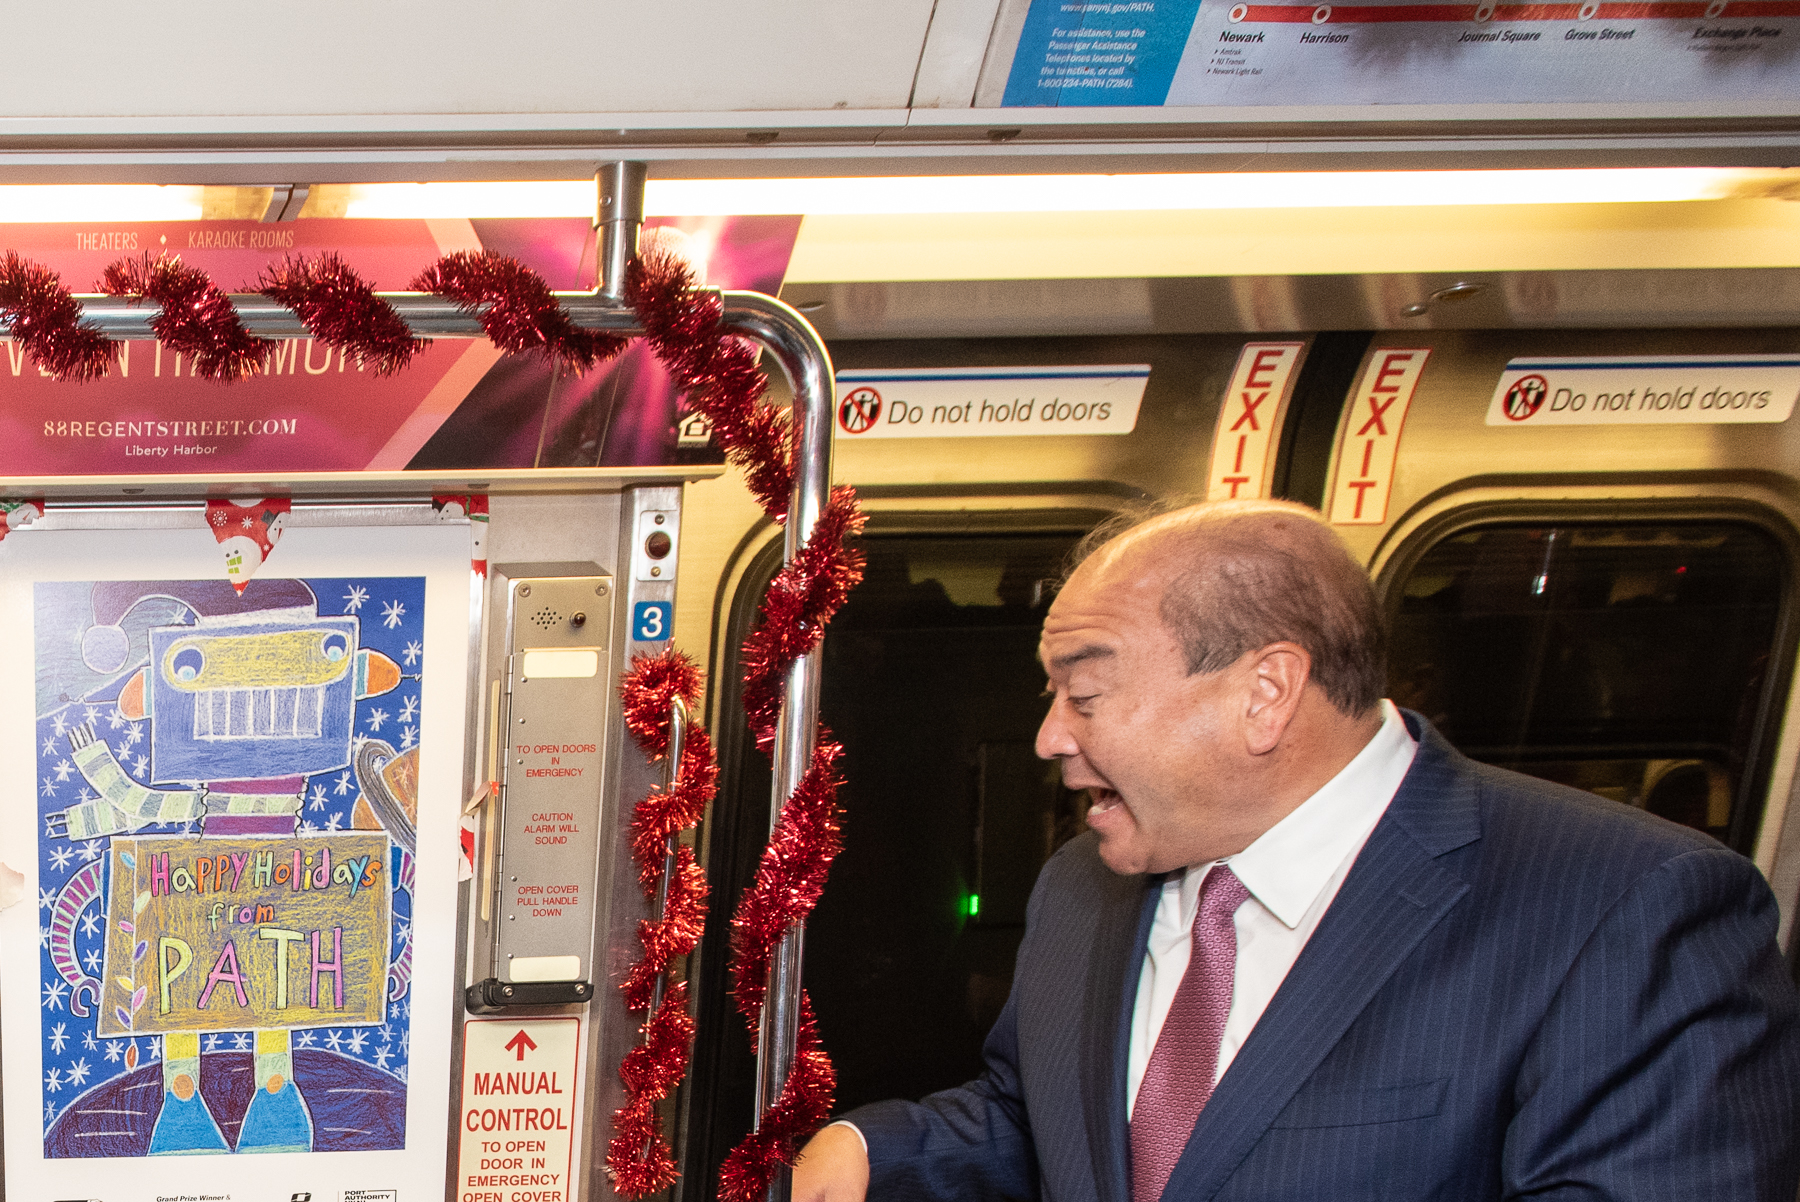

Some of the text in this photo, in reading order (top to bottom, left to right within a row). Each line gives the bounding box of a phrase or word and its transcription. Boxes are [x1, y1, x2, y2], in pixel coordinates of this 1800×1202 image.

[1051, 27, 1146, 38] For assistance, use the
[1219, 30, 1265, 42] Newark
[1300, 32, 1350, 44] Harrison
[1457, 30, 1541, 44] Journal Square
[1564, 28, 1636, 41] Grove Street
[1092, 41, 1138, 51] Assistance
[1092, 54, 1123, 63] located
[1124, 54, 1136, 64] by
[1041, 66, 1055, 76] the
[1098, 67, 1107, 76] or
[1108, 66, 1125, 76] call
[76, 230, 294, 250] THEATERS KARAOKE ROOMS
[1550, 386, 1772, 412] Do not hold doors
[888, 398, 1112, 424] Do not hold doors
[43, 418, 298, 438] 88REGENTSTREET.COM
[1222, 350, 1286, 499] EXIT
[1348, 353, 1414, 519] EXIT
[125, 443, 218, 457] Liberty Harbor
[641, 606, 663, 638] 3
[516, 744, 597, 754] TO OPEN DOORS
[551, 756, 560, 766] IN
[526, 768, 584, 778] EMERGENCY
[531, 812, 574, 822] CAUTION
[523, 824, 580, 834] ALARM WILL
[534, 835, 568, 845] SOUND
[254, 847, 383, 898] Holidays
[518, 884, 579, 895] OPEN COVER
[517, 896, 579, 906] PULL HANDLE
[207, 902, 274, 931] from
[532, 908, 562, 917] DOWN
[158, 926, 344, 1015] PATH
[473, 1071, 563, 1096] MANUAL
[466, 1107, 568, 1132] CONTROL
[481, 1140, 546, 1153] TO OPEN
[480, 1157, 545, 1170] DOOR IN
[467, 1174, 560, 1187] EMERGENCY
[199, 1194, 225, 1202] Winner
[511, 1191, 562, 1202] COVER
